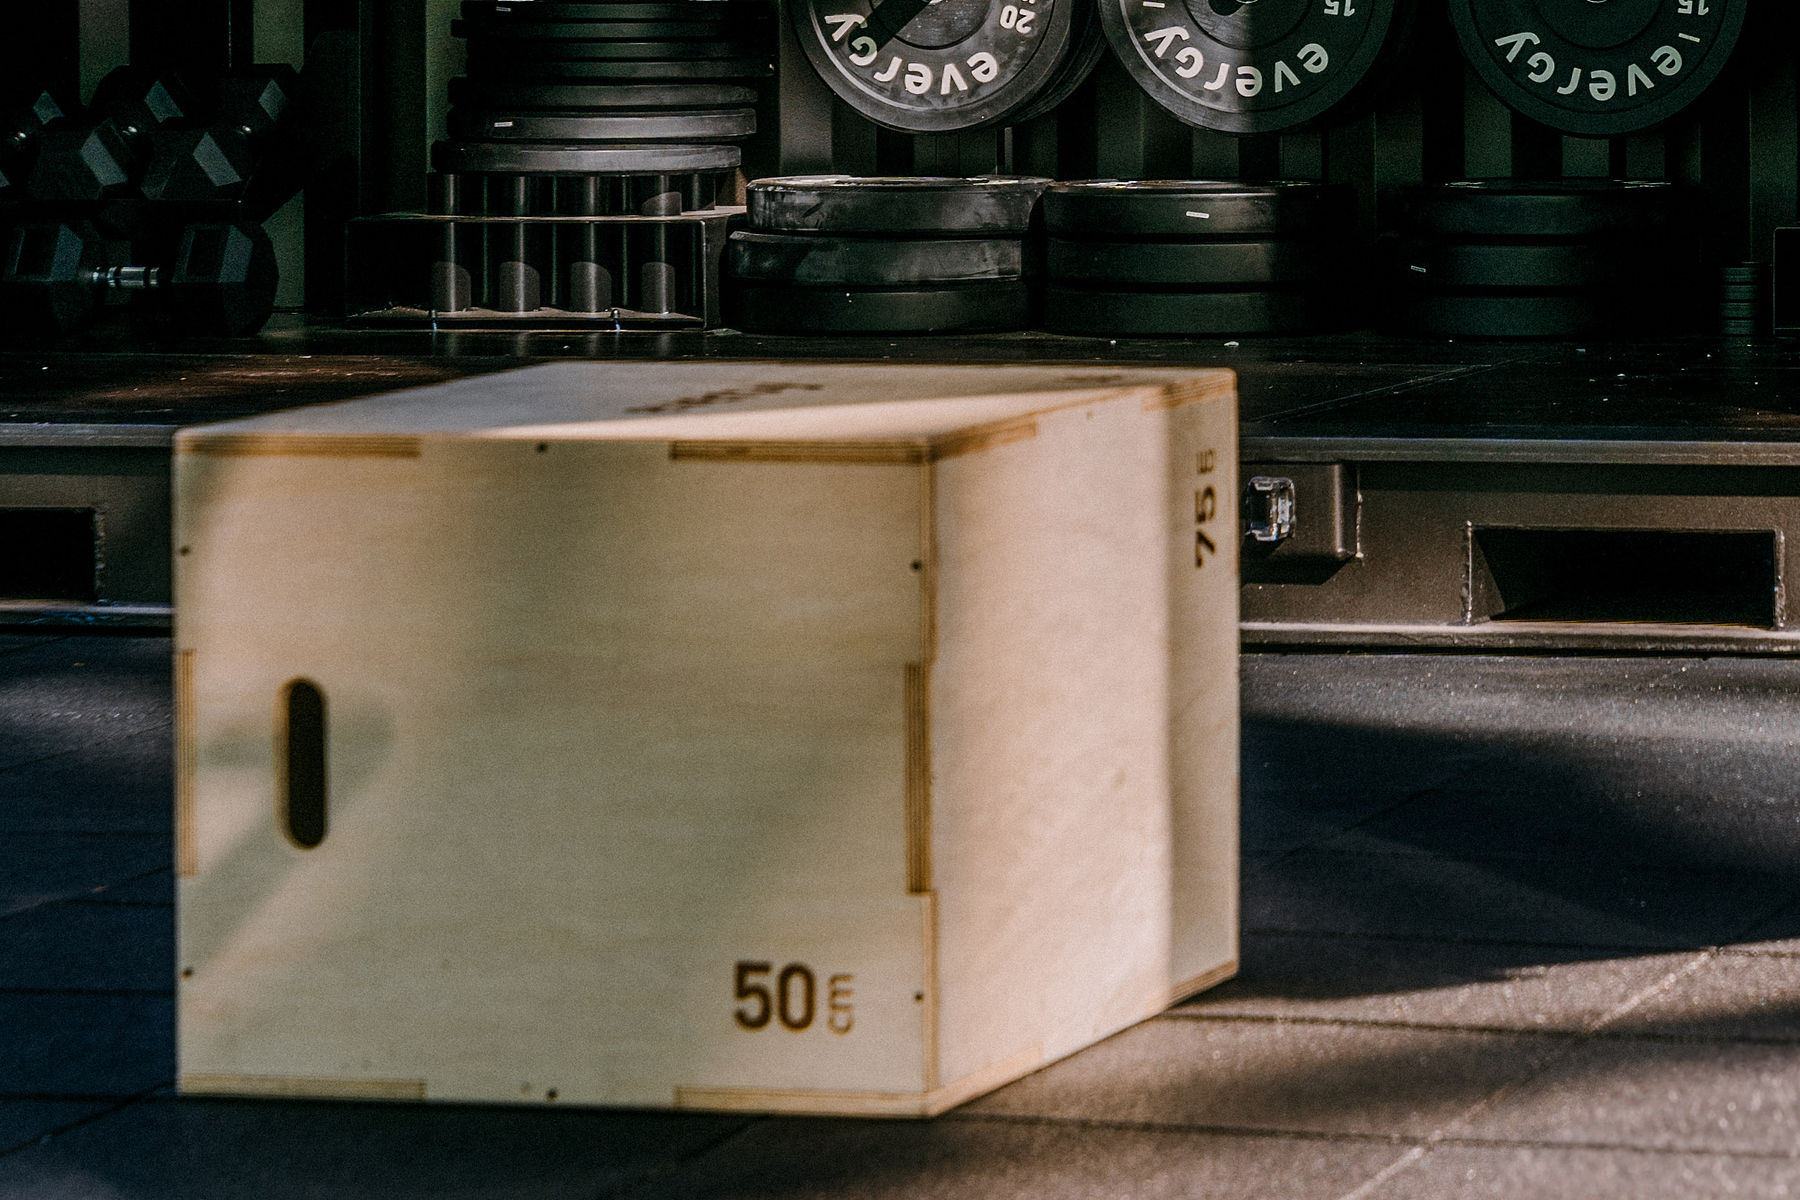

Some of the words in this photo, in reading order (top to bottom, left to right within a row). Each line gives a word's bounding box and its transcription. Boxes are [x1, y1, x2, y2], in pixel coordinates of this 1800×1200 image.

[999, 4, 1037, 35] 20
[1195, 485, 1216, 568] 75
[735, 961, 815, 1032] 50
